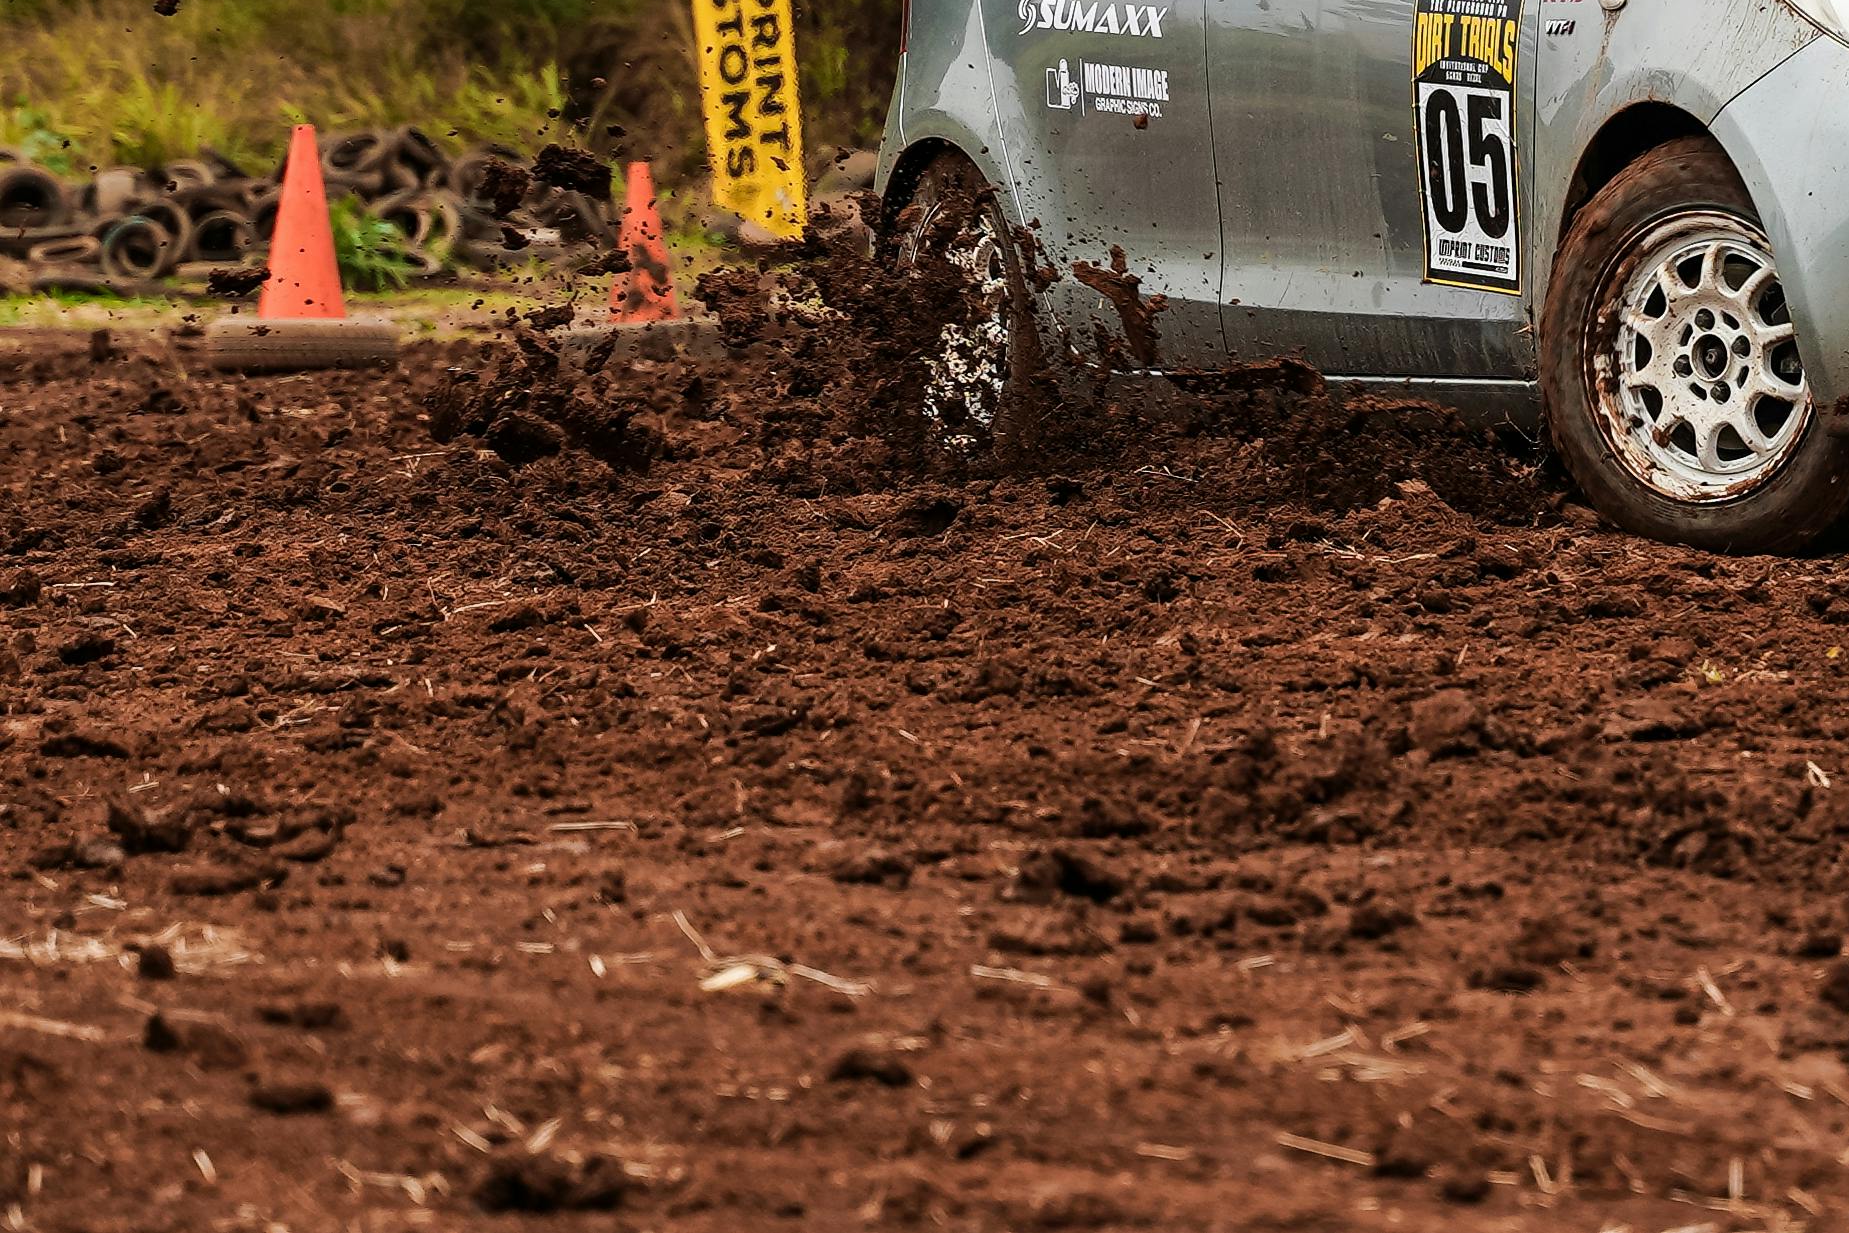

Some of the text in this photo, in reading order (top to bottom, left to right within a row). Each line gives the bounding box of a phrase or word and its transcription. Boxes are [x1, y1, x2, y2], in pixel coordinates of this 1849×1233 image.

[1416, 12, 1517, 85] DIRT TRIALS
[1084, 62, 1169, 102] MODERN IMAGE
[1095, 97, 1128, 115] GRAPHIC
[1149, 103, 1162, 117] CO.
[1425, 88, 1509, 240] 05
